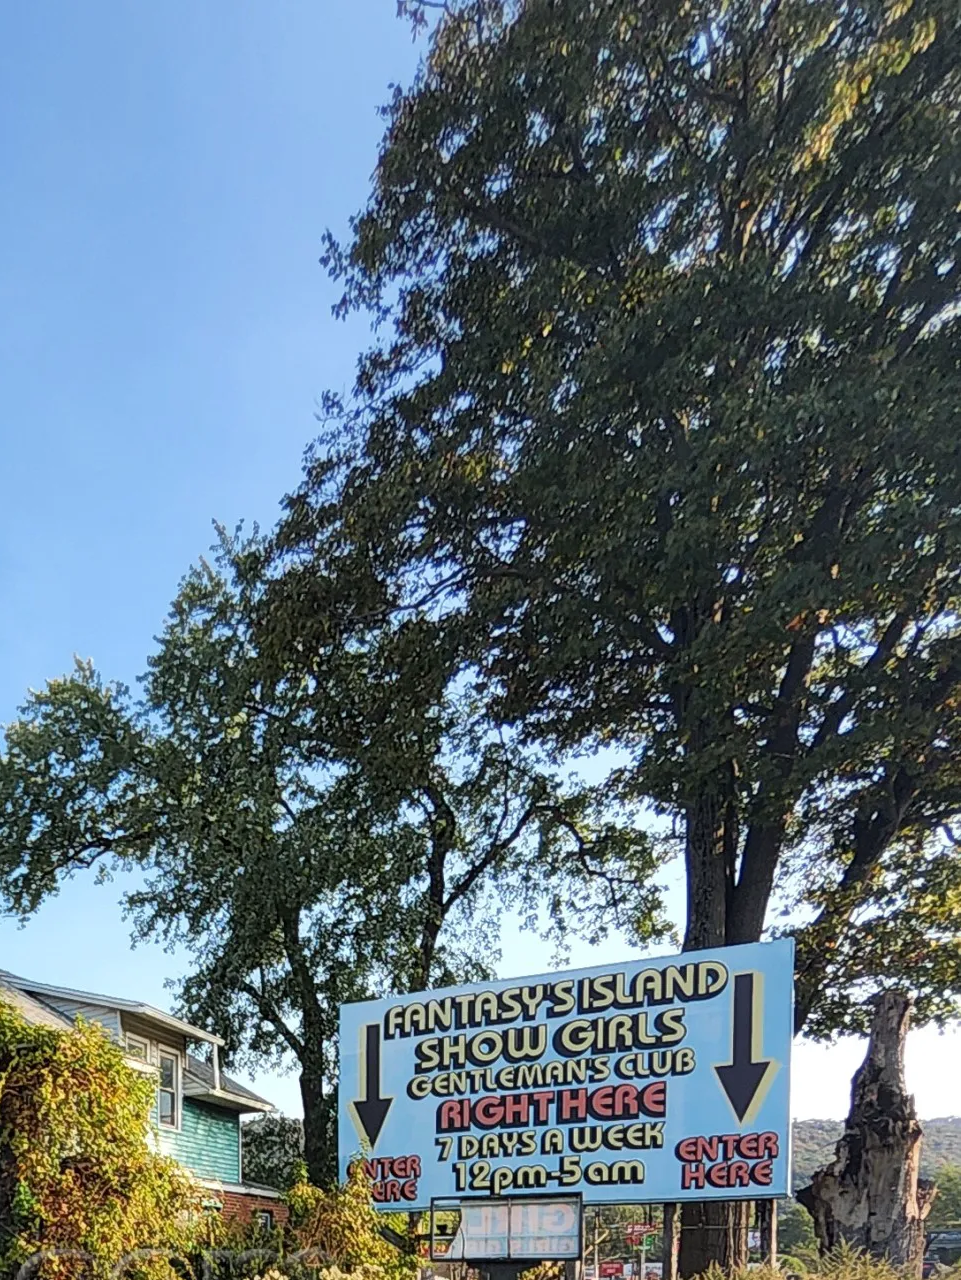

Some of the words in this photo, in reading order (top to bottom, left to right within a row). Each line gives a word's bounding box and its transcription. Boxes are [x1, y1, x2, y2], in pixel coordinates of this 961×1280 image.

[384, 978, 576, 1039] FANTASY'S
[582, 961, 728, 1009] ISLAND
[415, 1023, 548, 1074] SHOW
[554, 1008, 687, 1058] GIRLS
[407, 1055, 611, 1099] GENTLEMAN'S
[619, 1048, 696, 1079] CLUB
[437, 1091, 556, 1134] RIGHT
[561, 1082, 667, 1121] HERE
[437, 1137, 454, 1162] 7
[460, 1130, 537, 1160] DAYS
[543, 1129, 564, 1154] A
[570, 1122, 665, 1153] WEEK
[676, 1132, 779, 1163] ENTER
[370, 1179, 418, 1203] ERE
[681, 1159, 774, 1190] HERE
